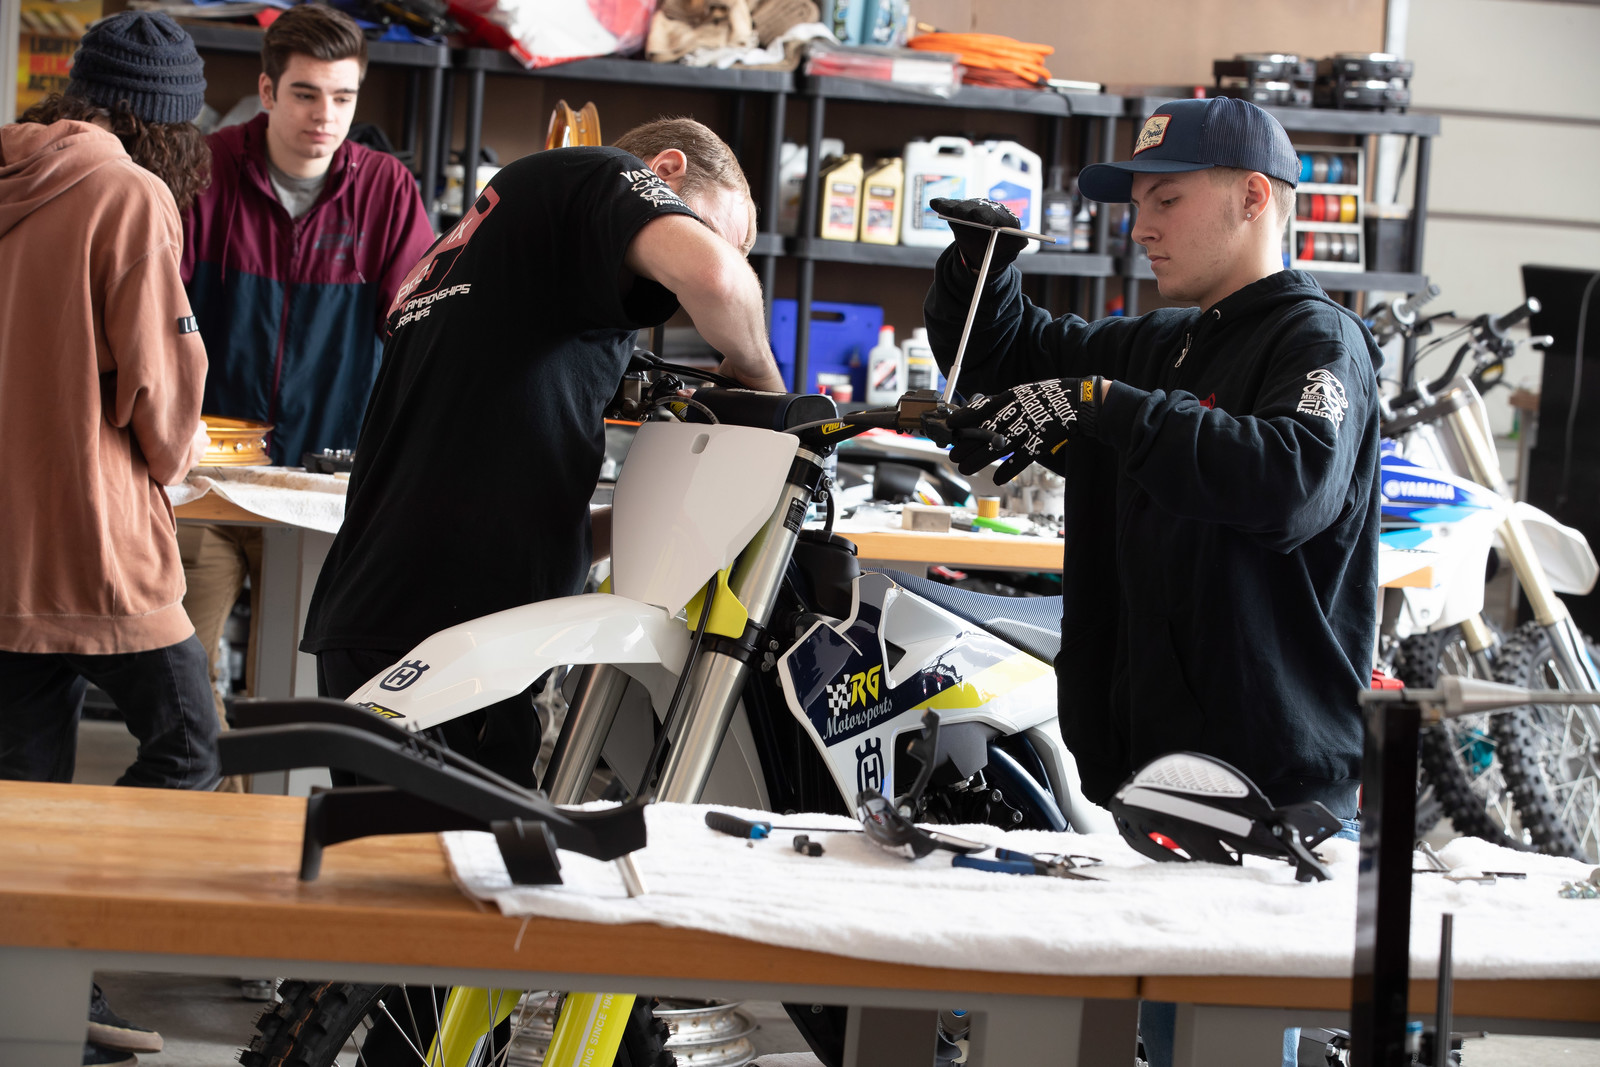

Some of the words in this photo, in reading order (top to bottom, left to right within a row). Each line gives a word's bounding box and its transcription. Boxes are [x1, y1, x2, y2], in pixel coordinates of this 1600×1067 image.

[1399, 480, 1455, 500] YAMAHA
[850, 664, 883, 707] RG
[822, 696, 893, 740] Motorsports
[581, 1047, 596, 1067] ING
[590, 1012, 608, 1046] SINCE
[602, 992, 615, 1010] 190
